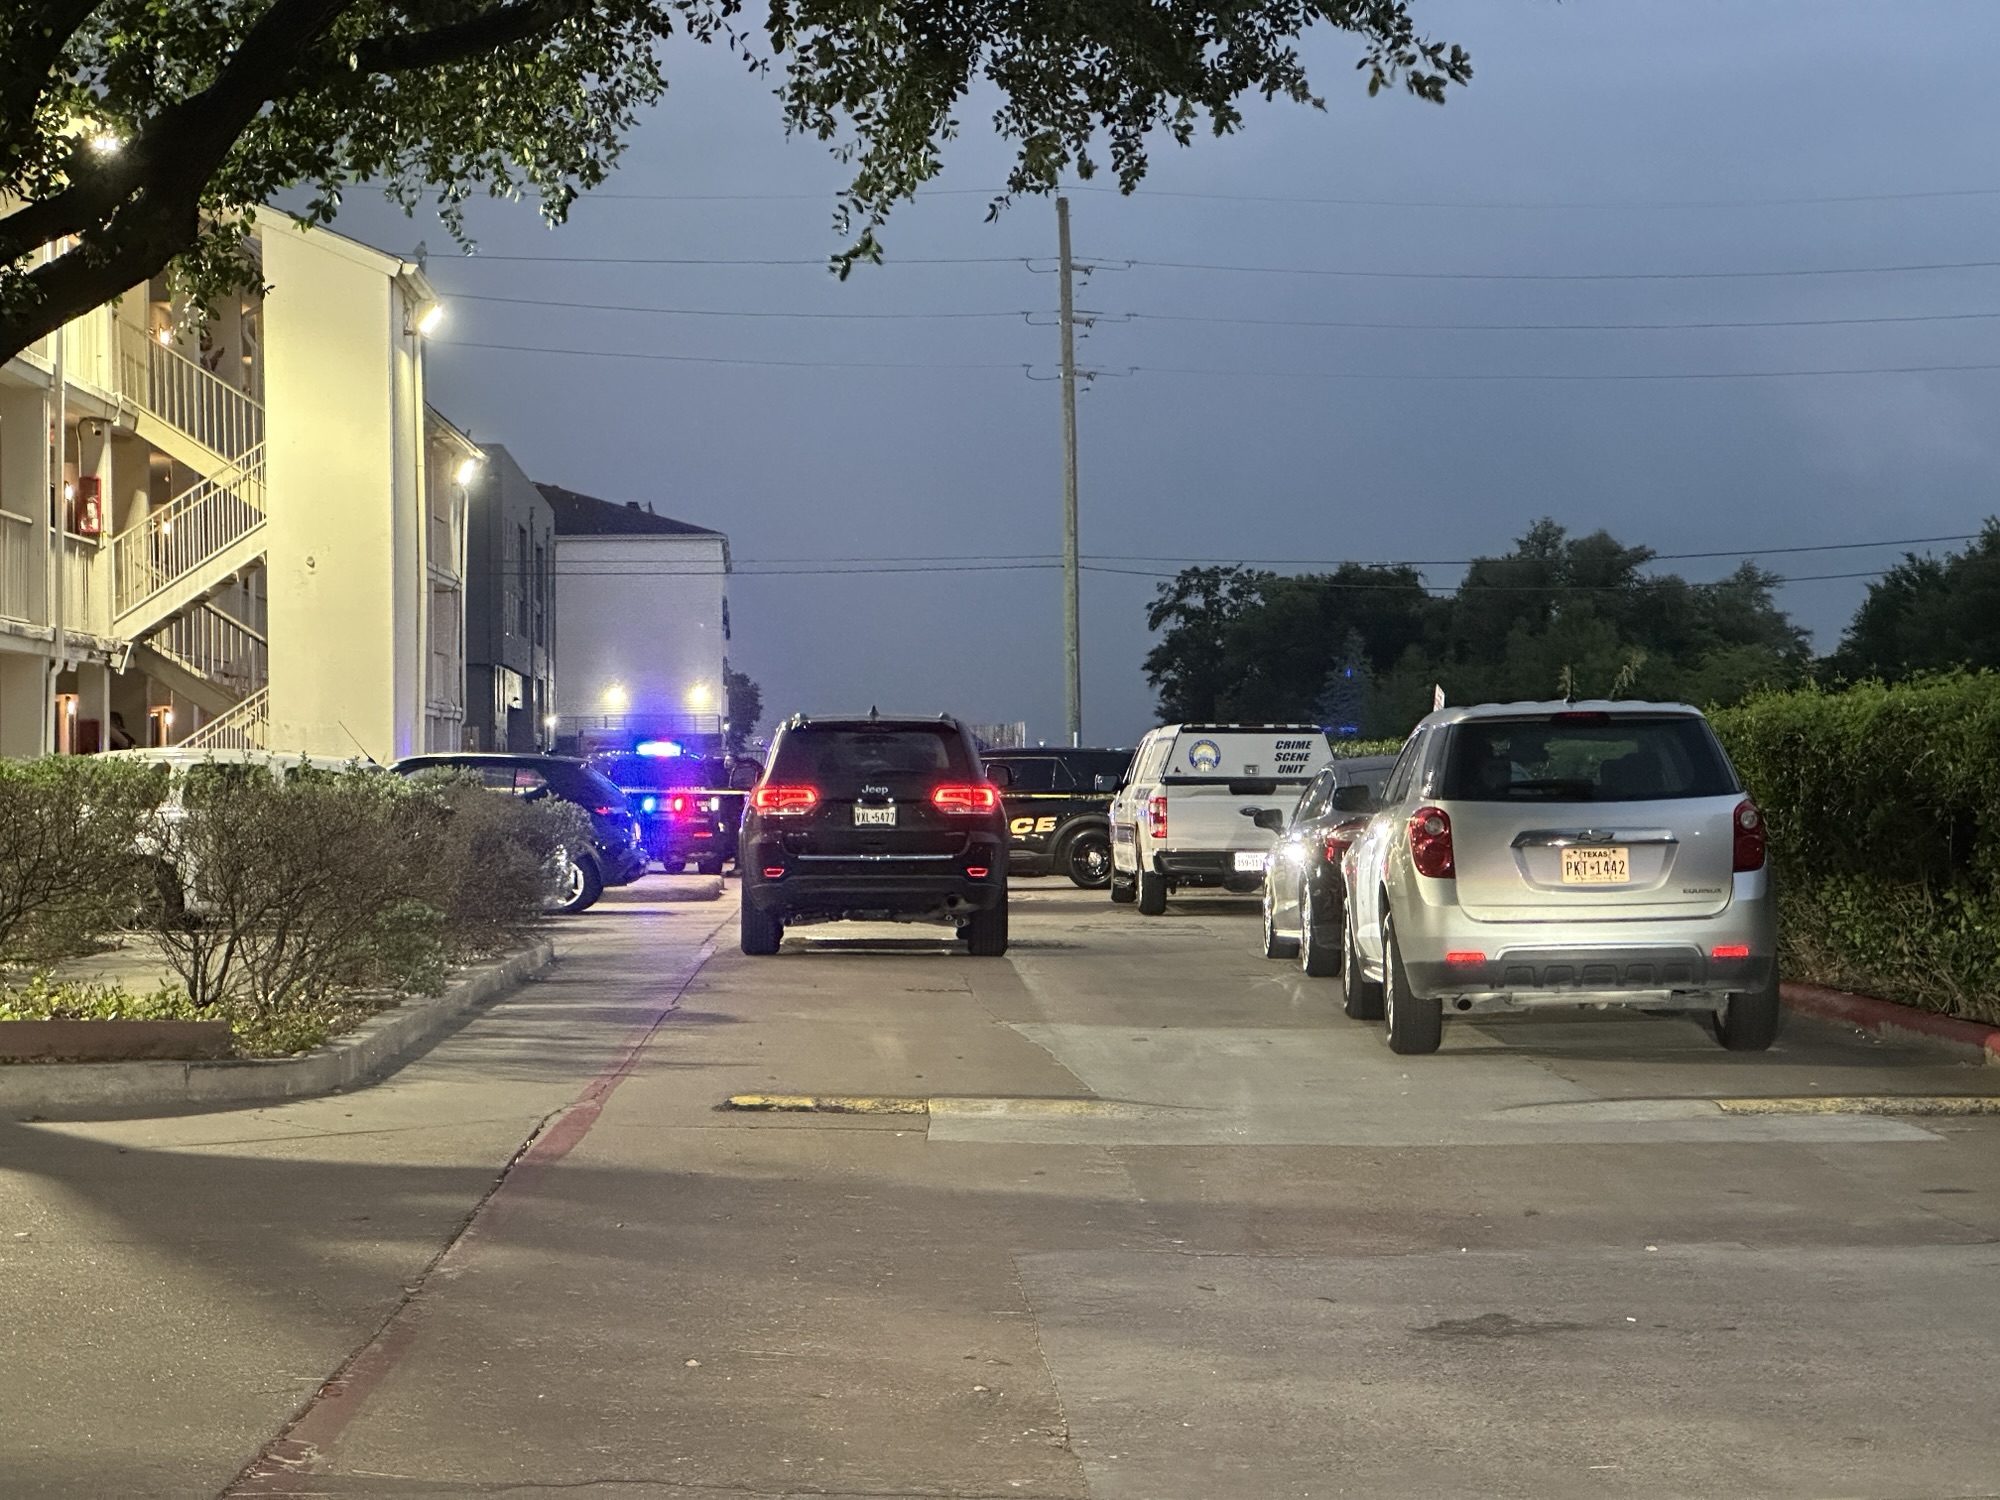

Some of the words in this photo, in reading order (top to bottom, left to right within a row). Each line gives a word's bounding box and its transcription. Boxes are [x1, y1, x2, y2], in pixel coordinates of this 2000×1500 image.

[1275, 740, 1312, 750] CRIME
[1274, 752, 1311, 762] SCENE
[1277, 764, 1306, 774] UNIT
[861, 784, 889, 796] Jeep
